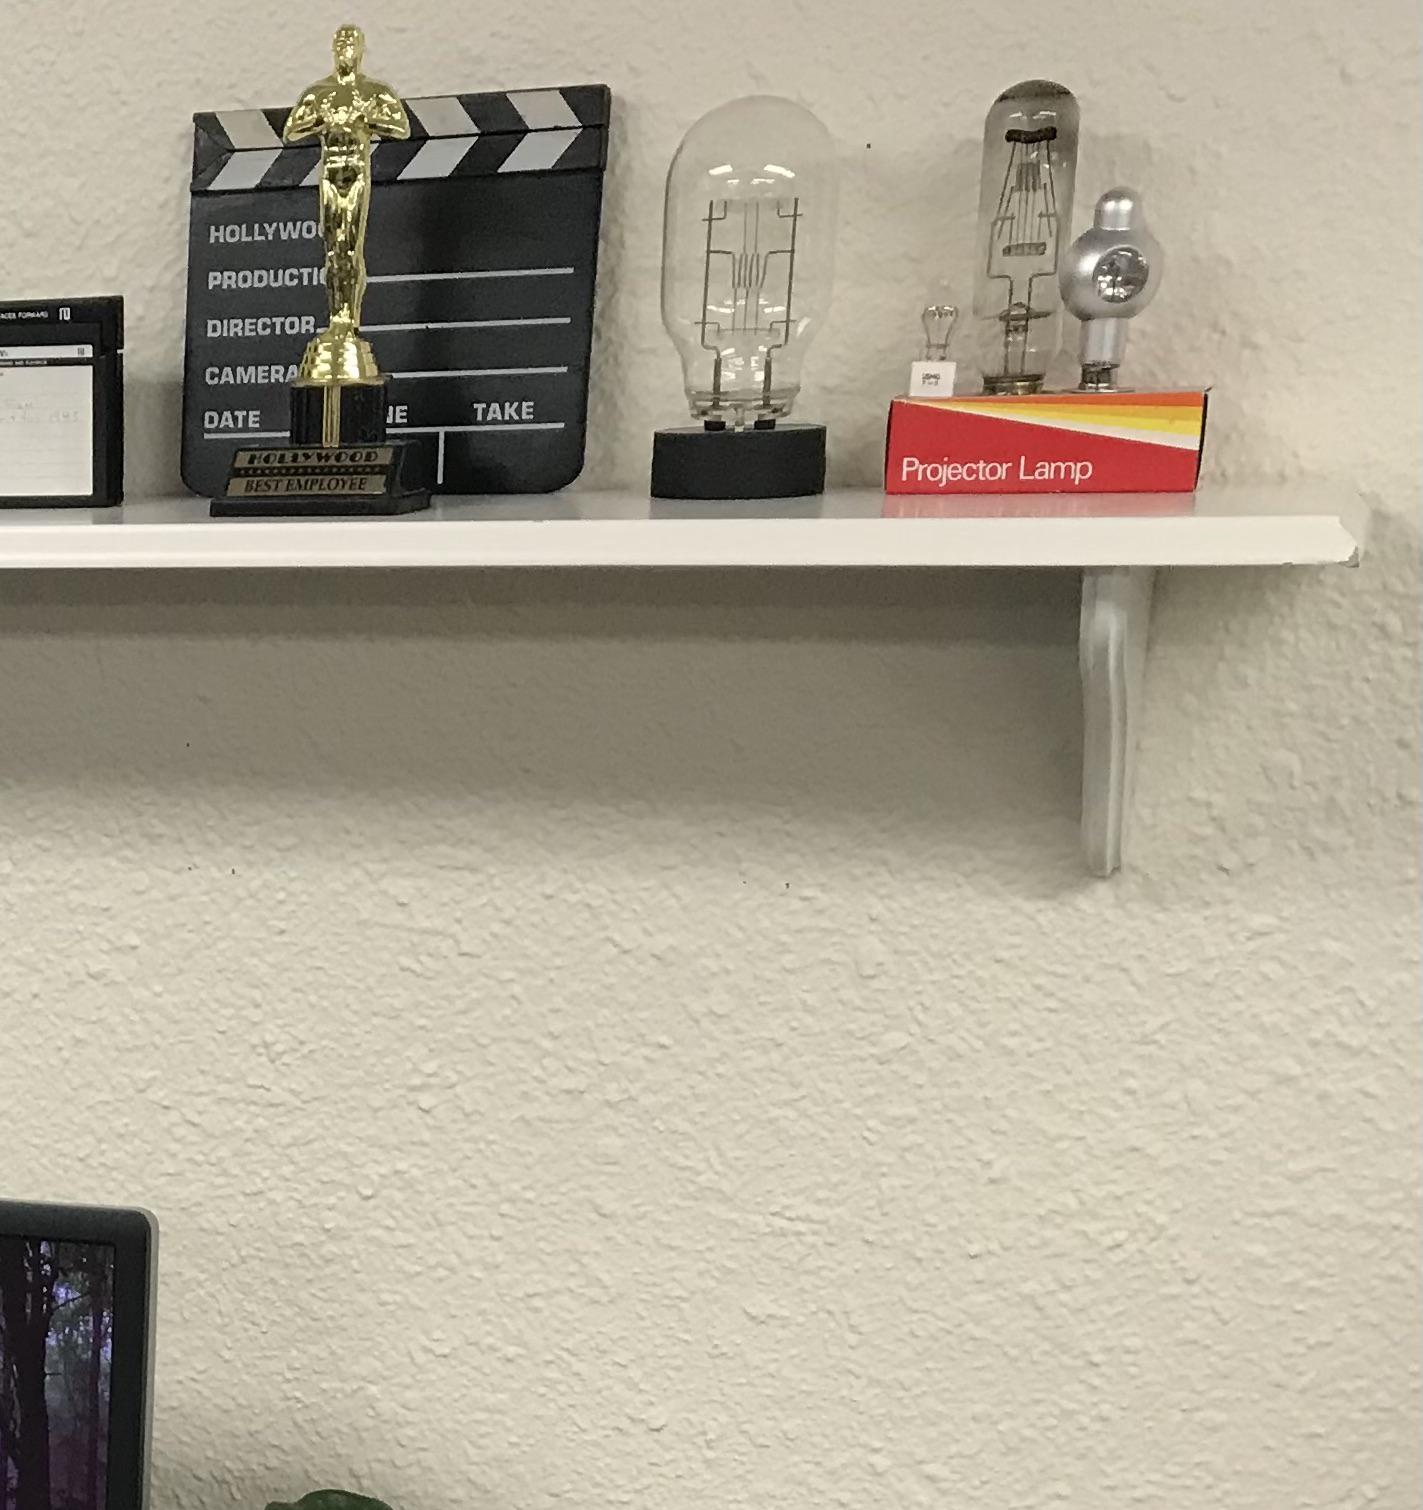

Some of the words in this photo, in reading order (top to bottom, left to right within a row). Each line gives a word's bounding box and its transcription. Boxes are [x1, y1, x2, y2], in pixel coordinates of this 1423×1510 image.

[206, 316, 316, 337] DIRECTOR
[205, 364, 298, 385] CAMERA
[204, 410, 260, 429] DATE
[473, 401, 535, 421] TAKE
[248, 450, 379, 464] HOLLYWOOD
[901, 456, 1012, 487] Projector
[1019, 455, 1093, 485] Lamp
[244, 479, 283, 492] BEST
[285, 477, 368, 492] EMPLOYEE
